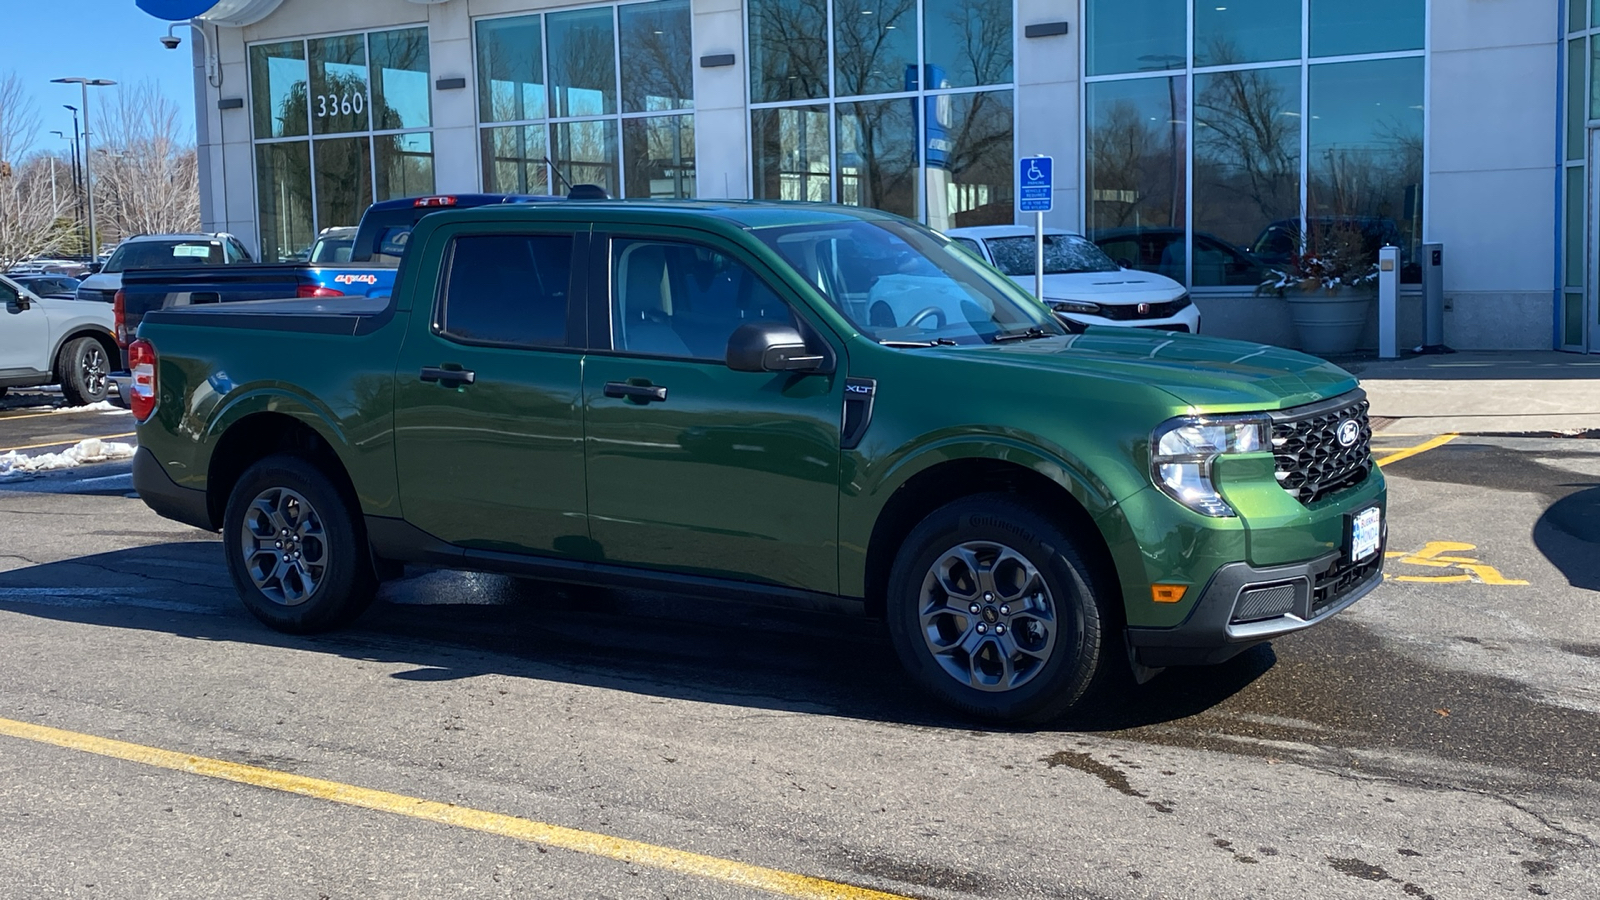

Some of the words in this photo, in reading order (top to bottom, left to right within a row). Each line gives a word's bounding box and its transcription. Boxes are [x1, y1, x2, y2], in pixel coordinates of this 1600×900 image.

[317, 92, 364, 117] 3360
[846, 385, 873, 393] XLT
[969, 513, 1036, 544] Continental
[1360, 526, 1379, 545] HONDA
